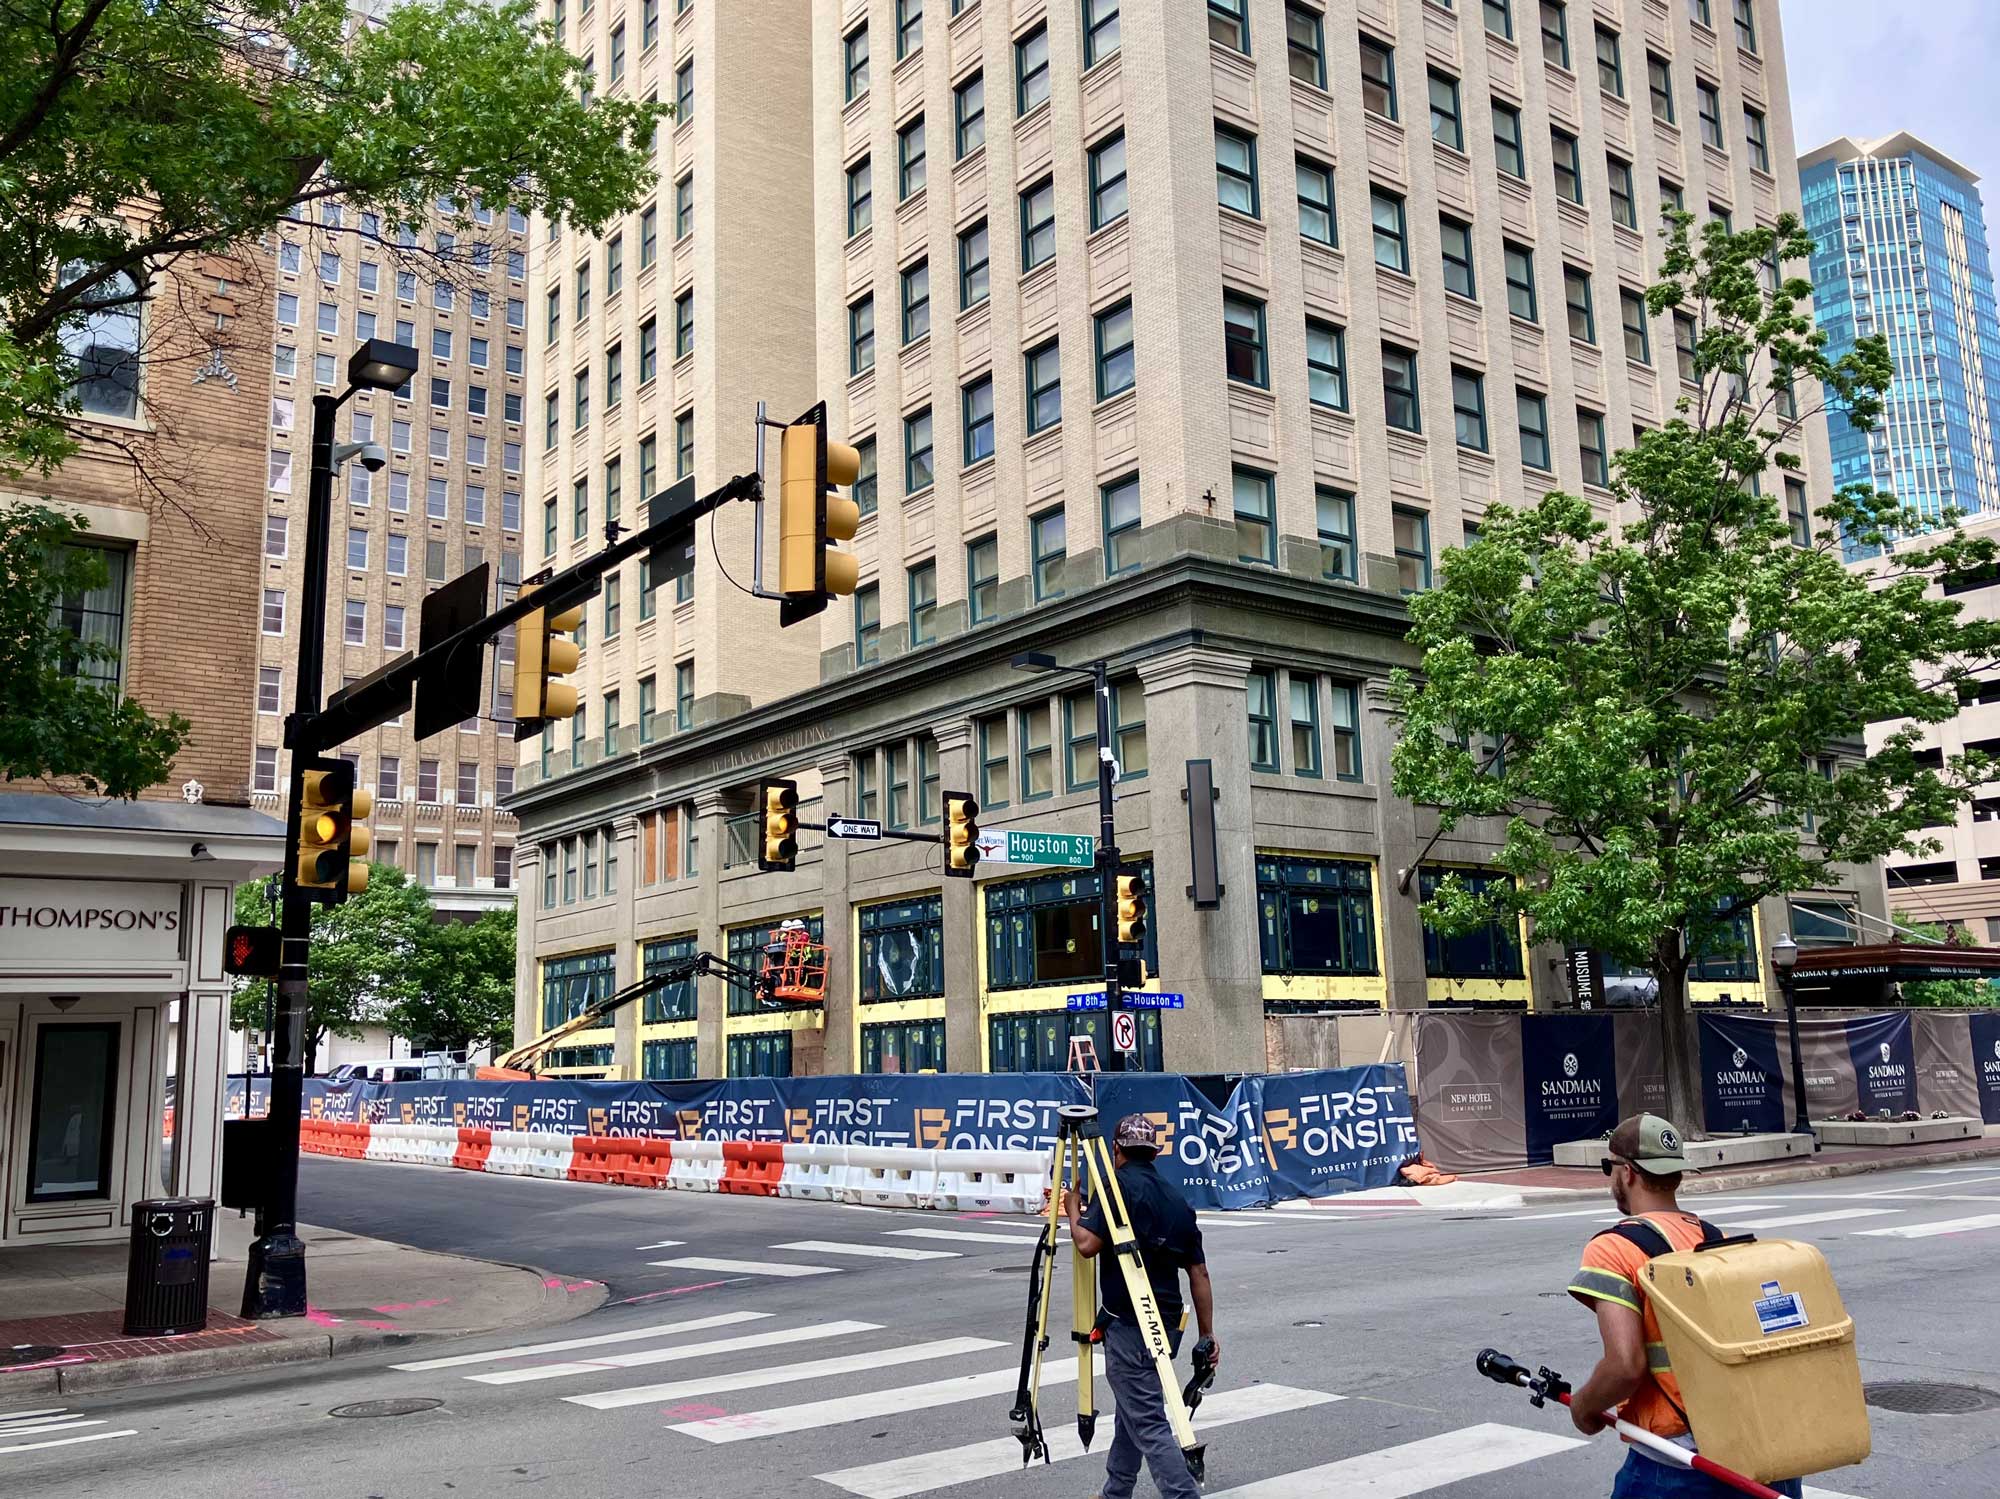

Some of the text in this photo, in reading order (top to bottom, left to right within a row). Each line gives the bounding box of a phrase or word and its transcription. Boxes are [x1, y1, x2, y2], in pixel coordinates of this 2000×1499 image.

[843, 824, 876, 834] ONE WAY
[1011, 834, 1090, 856] Houston St
[1021, 854, 1034, 862] 900
[1069, 856, 1082, 864] 800
[0, 906, 178, 931] THOMPSON'S
[1574, 951, 1592, 998] MUSUME
[1791, 966, 1889, 979] ANDMAN SIGNATURE
[1076, 995, 1098, 1007] W 8th
[1134, 993, 1170, 1006] Houston
[1716, 1071, 1767, 1085] SANDMAN
[1868, 1063, 1906, 1079] SANDMAN
[1541, 1079, 1600, 1096] SANDMAN
[1718, 1086, 1766, 1096] SIGNATURE
[325, 1092, 353, 1110] FIRST
[413, 1096, 447, 1115] FIRST
[466, 1096, 505, 1118] FIRST
[1299, 1086, 1396, 1124] FIRST
[1450, 1093, 1493, 1104] NEW HOTEL
[1542, 1096, 1600, 1108] SIGNATURE
[531, 1098, 578, 1121] FIRST
[610, 1100, 662, 1125] FIRST
[704, 1099, 771, 1125] FIRST
[815, 1098, 892, 1126] FIRST
[956, 1099, 1061, 1130] FIRST
[1303, 1116, 1417, 1157] ONSITE
[1311, 1161, 1358, 1176] PROPERTY
[1140, 1293, 1166, 1356] Tri-Max
